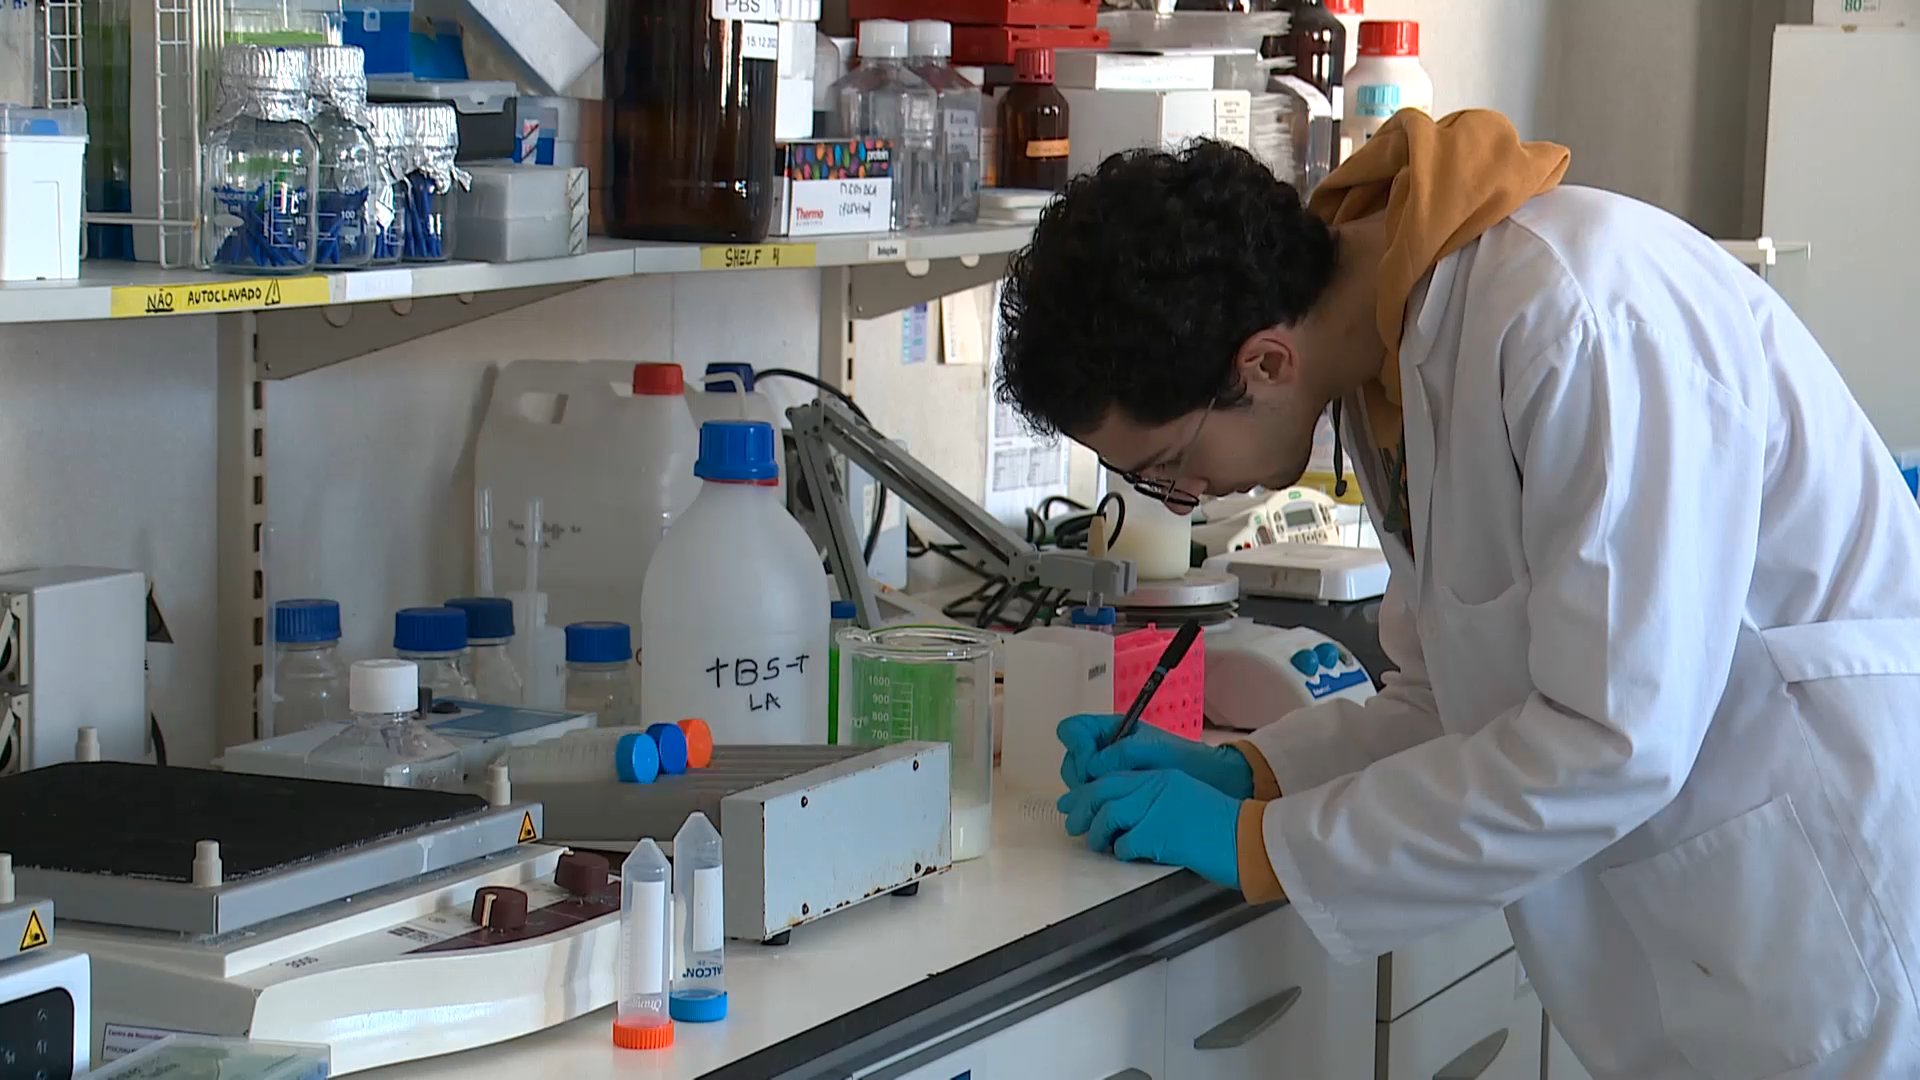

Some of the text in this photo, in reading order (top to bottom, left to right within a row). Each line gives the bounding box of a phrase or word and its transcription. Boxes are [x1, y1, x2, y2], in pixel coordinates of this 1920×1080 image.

[725, 0, 760, 13] PBS
[867, 150, 889, 162] protein
[341, 211, 356, 219] 100
[796, 208, 824, 220] Thermo
[725, 248, 762, 267] SHELF
[146, 286, 262, 311] NÃO AUTOCLAVADO
[869, 675, 890, 687] 1000
[749, 692, 781, 712] LA
[872, 693, 890, 705] 900
[872, 711, 889, 723] 800
[871, 729, 889, 740] 700
